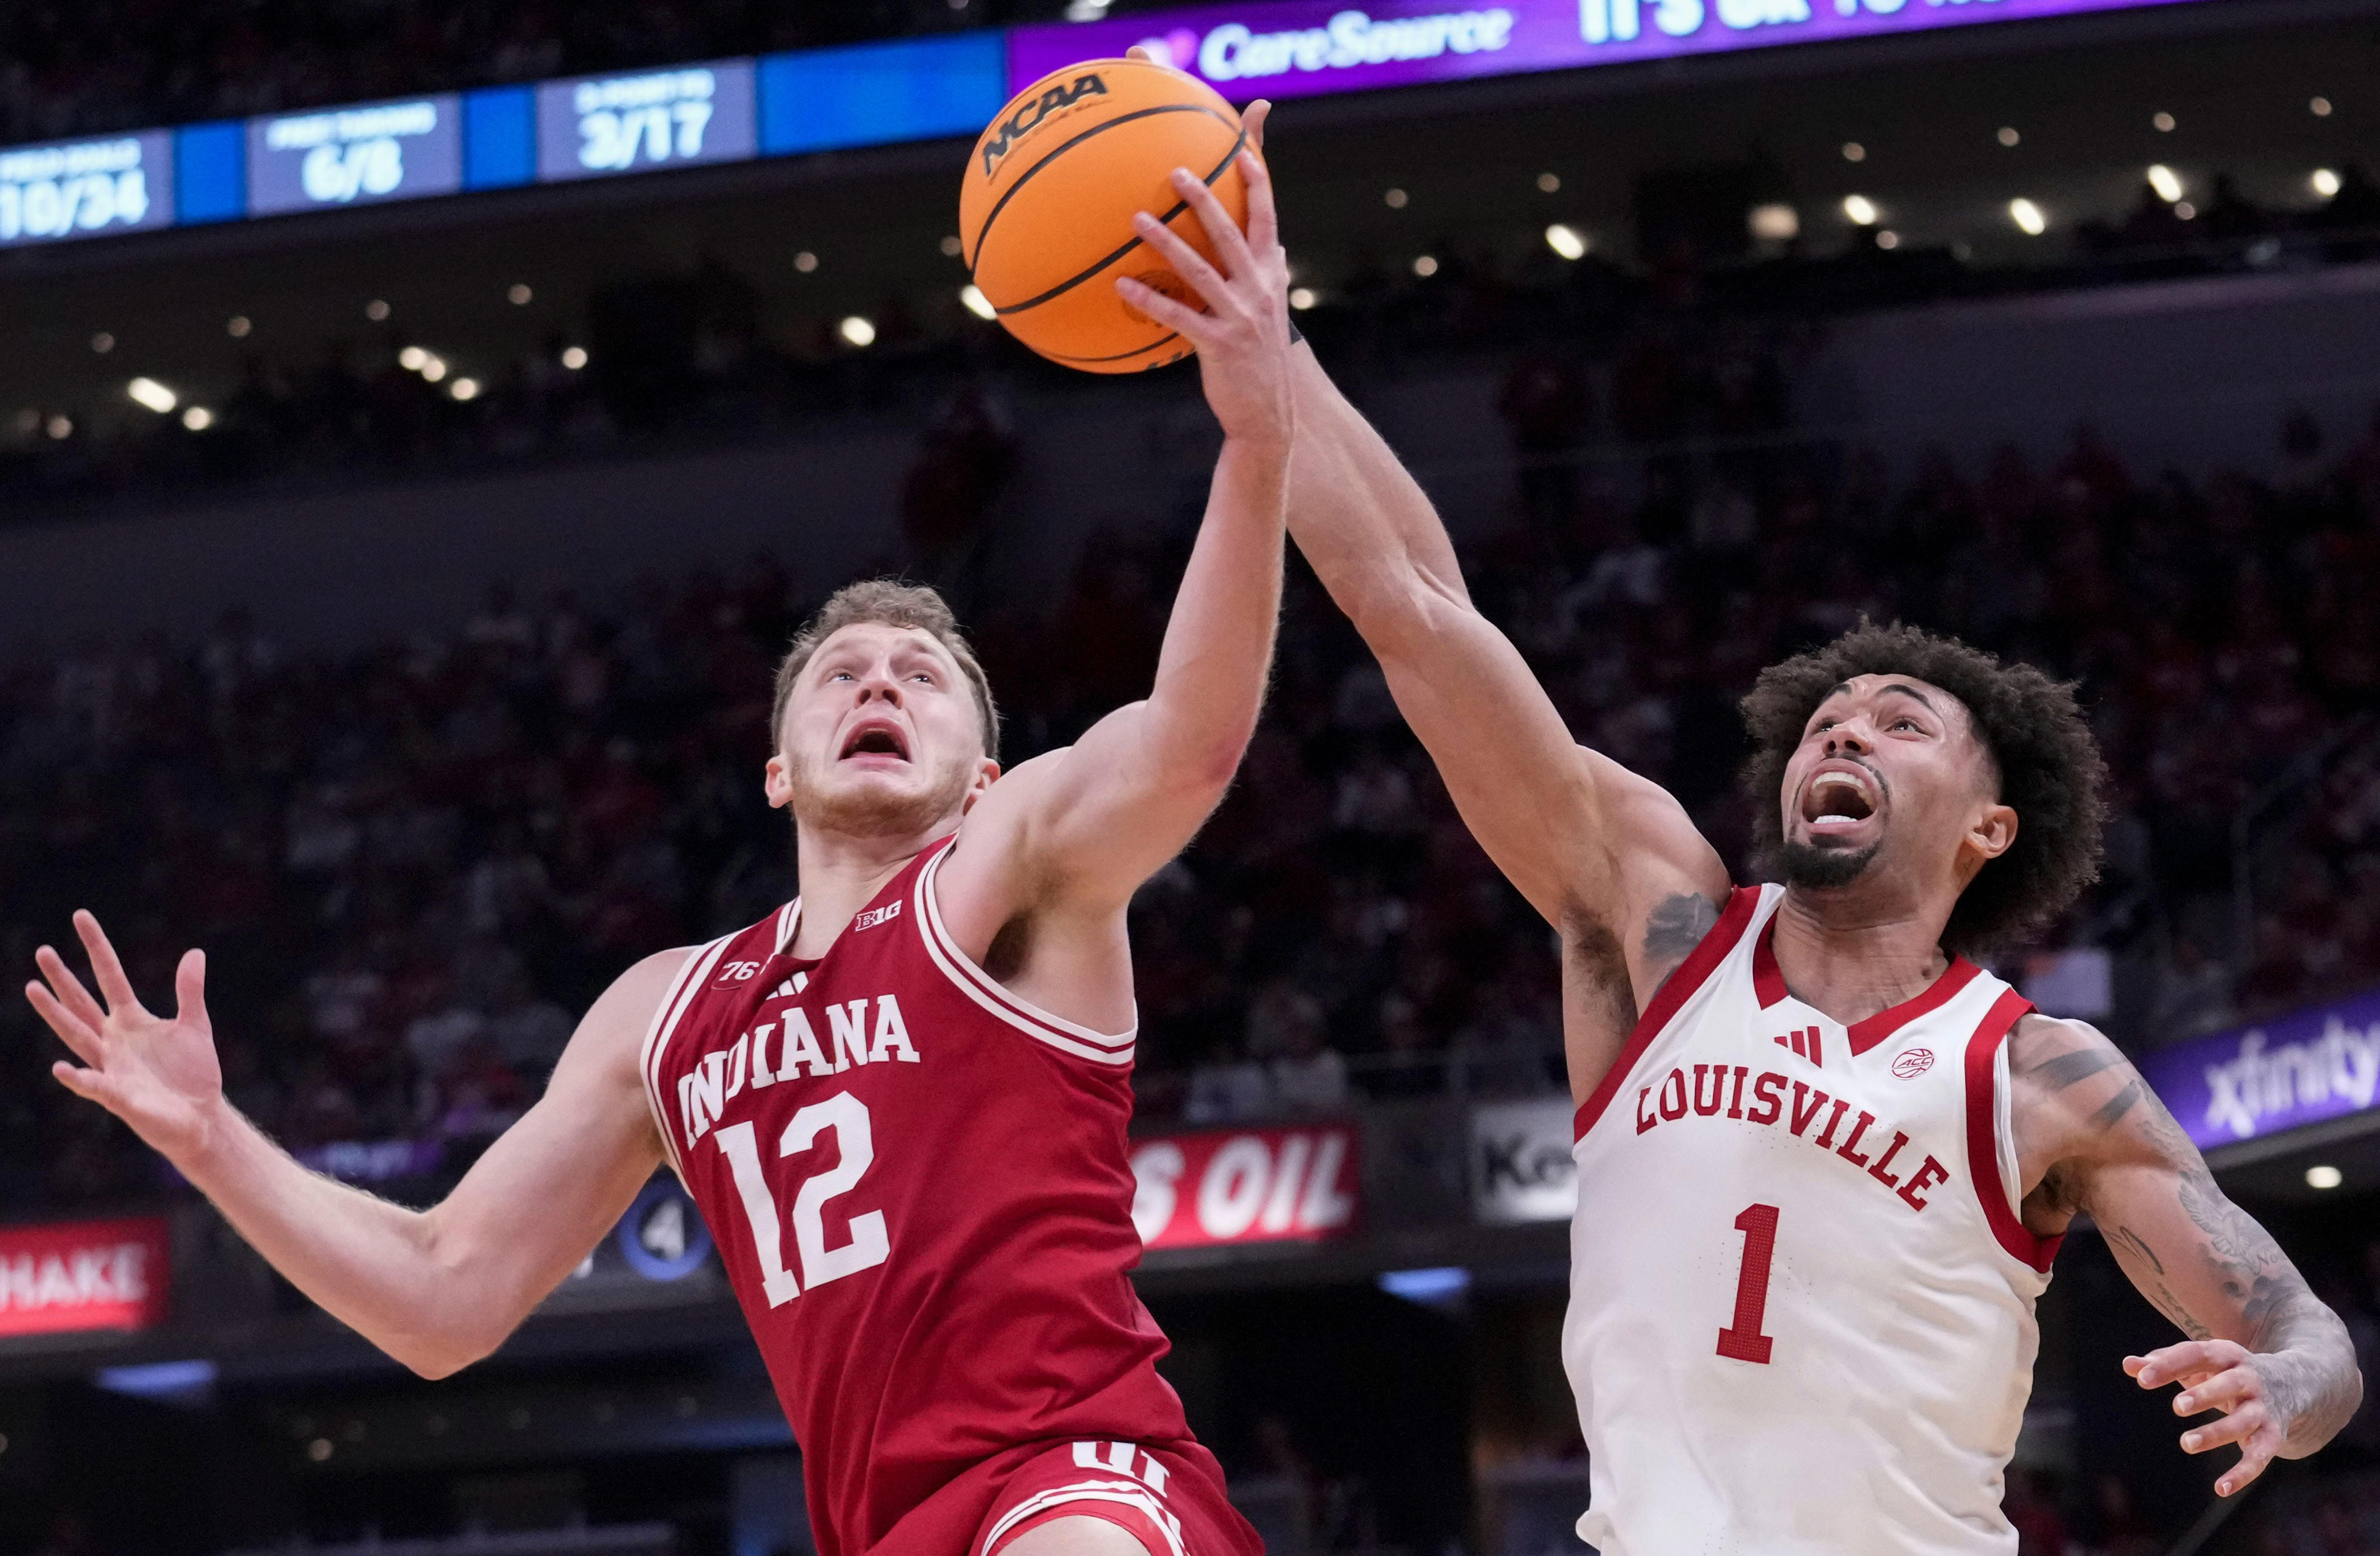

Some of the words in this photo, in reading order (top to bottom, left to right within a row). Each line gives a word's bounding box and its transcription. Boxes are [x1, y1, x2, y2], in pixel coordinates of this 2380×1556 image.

[1199, 8, 1513, 81] CareSource
[578, 101, 713, 170] 3/17
[983, 74, 1107, 176] NCAA
[719, 961, 760, 981] 76
[678, 994, 920, 1150] INDIANA
[1896, 1056, 1933, 1067] ACC
[2205, 1015, 2380, 1139] xfinity
[1196, 1133, 1354, 1239] OIL
[1636, 1064, 1950, 1211] LOUISVILLE
[643, 1198, 685, 1260] 4
[714, 1090, 890, 1309] 12
[1716, 1203, 1779, 1364] 1
